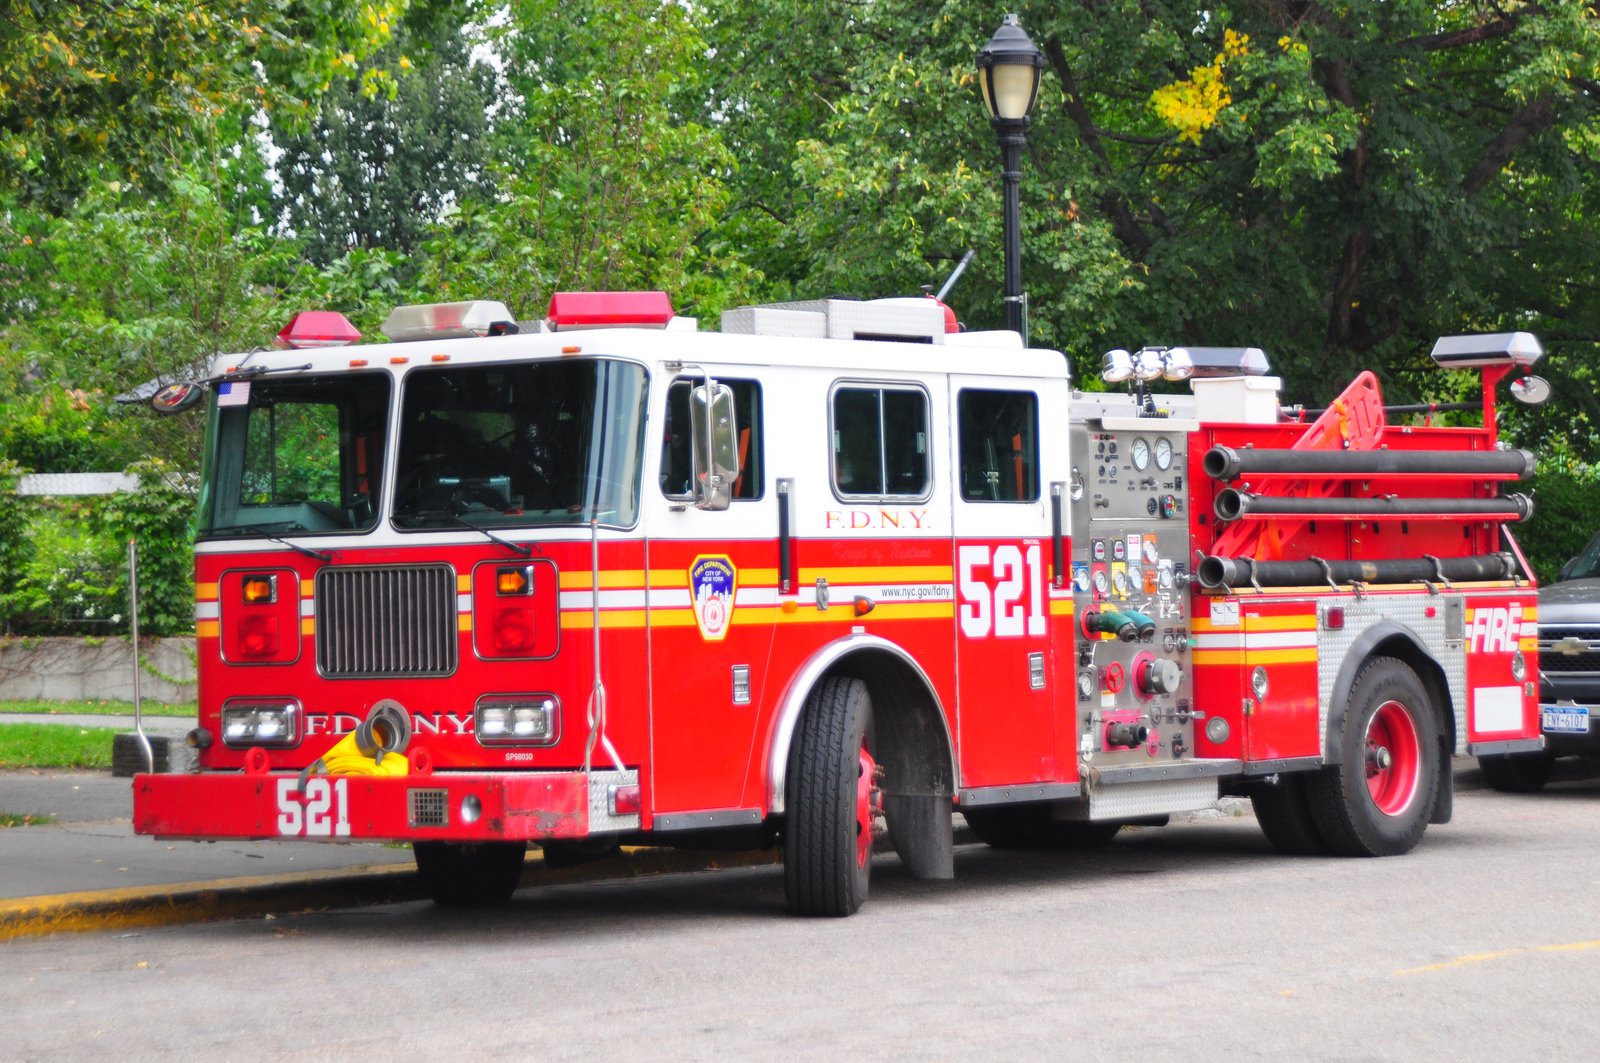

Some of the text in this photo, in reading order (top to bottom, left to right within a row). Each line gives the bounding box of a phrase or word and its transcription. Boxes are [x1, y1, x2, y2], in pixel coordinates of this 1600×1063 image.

[881, 585, 950, 599] www.nyc.gov/fdny
[959, 545, 1046, 637] 521
[1470, 606, 1523, 653] FIRE
[276, 777, 351, 837] 521
